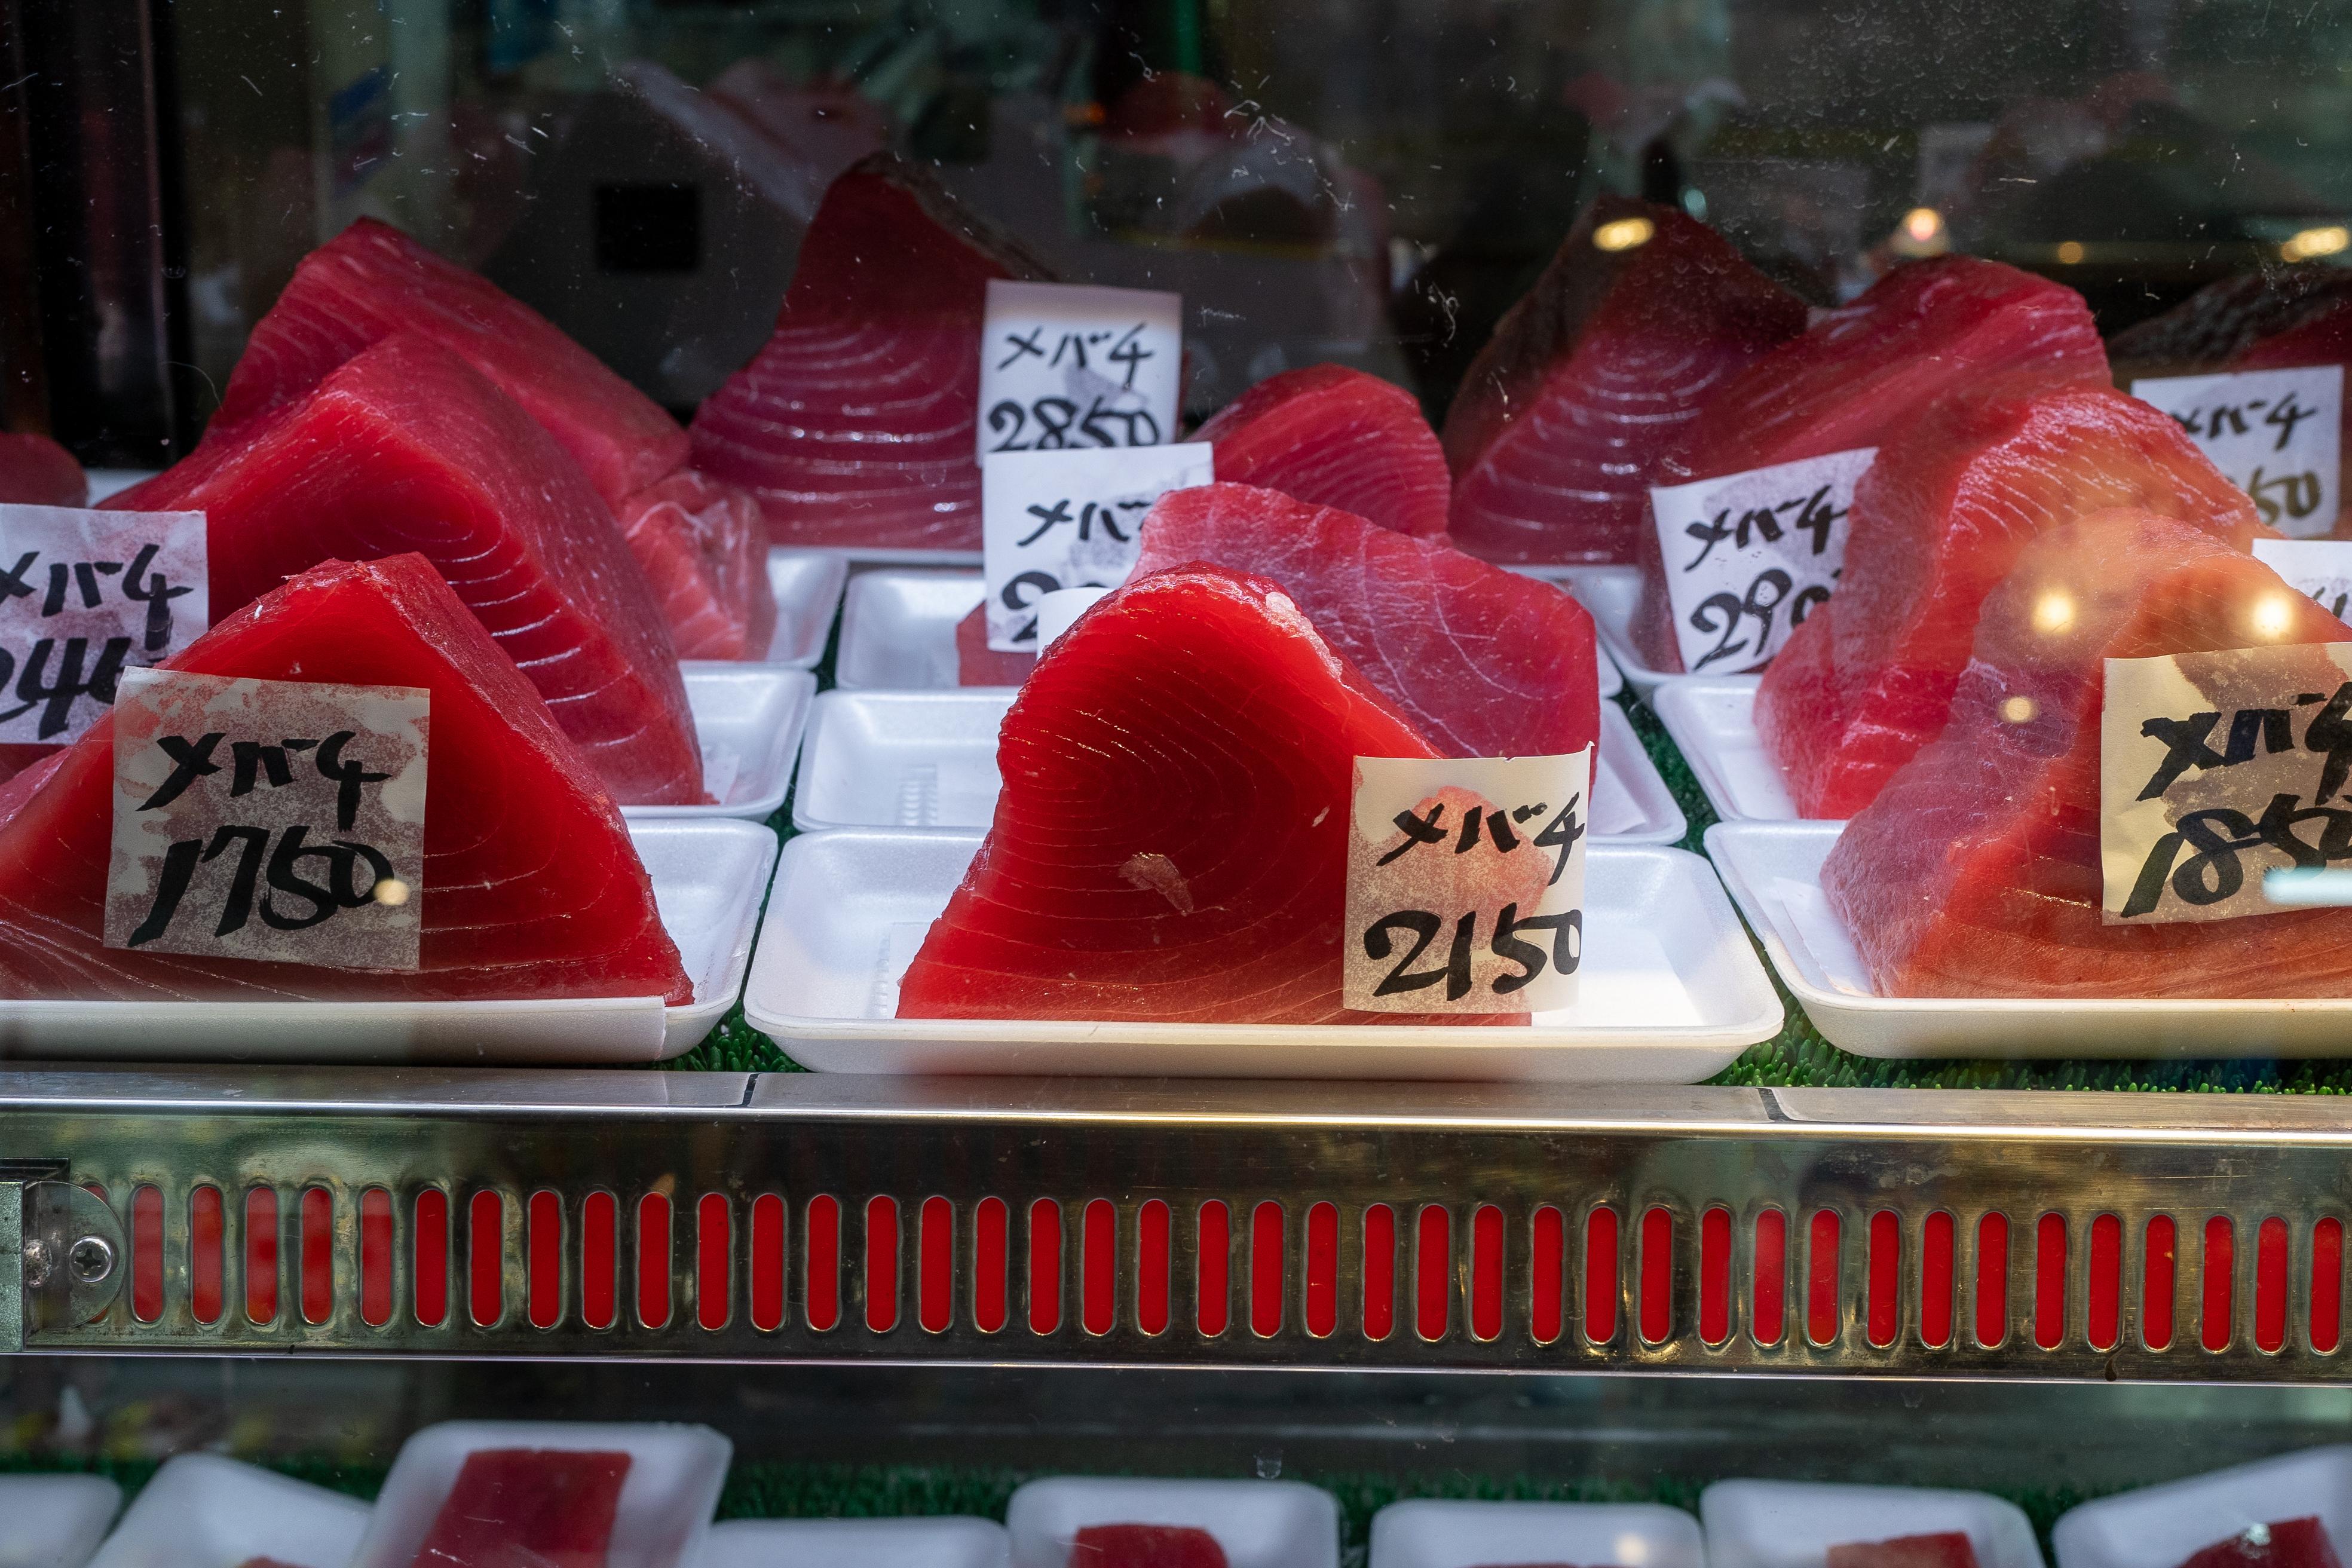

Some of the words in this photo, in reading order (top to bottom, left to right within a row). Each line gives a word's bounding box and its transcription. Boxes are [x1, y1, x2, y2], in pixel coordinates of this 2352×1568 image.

[997, 323, 1154, 390] メバチ
[988, 396, 1160, 452] 2850
[1015, 498, 1153, 547] メバ
[1684, 485, 1849, 572] メバチ
[136, 730, 391, 832] メバチ
[1376, 792, 1585, 887] メバチ
[127, 825, 395, 947] 1750
[1363, 902, 1582, 1002] 2150
